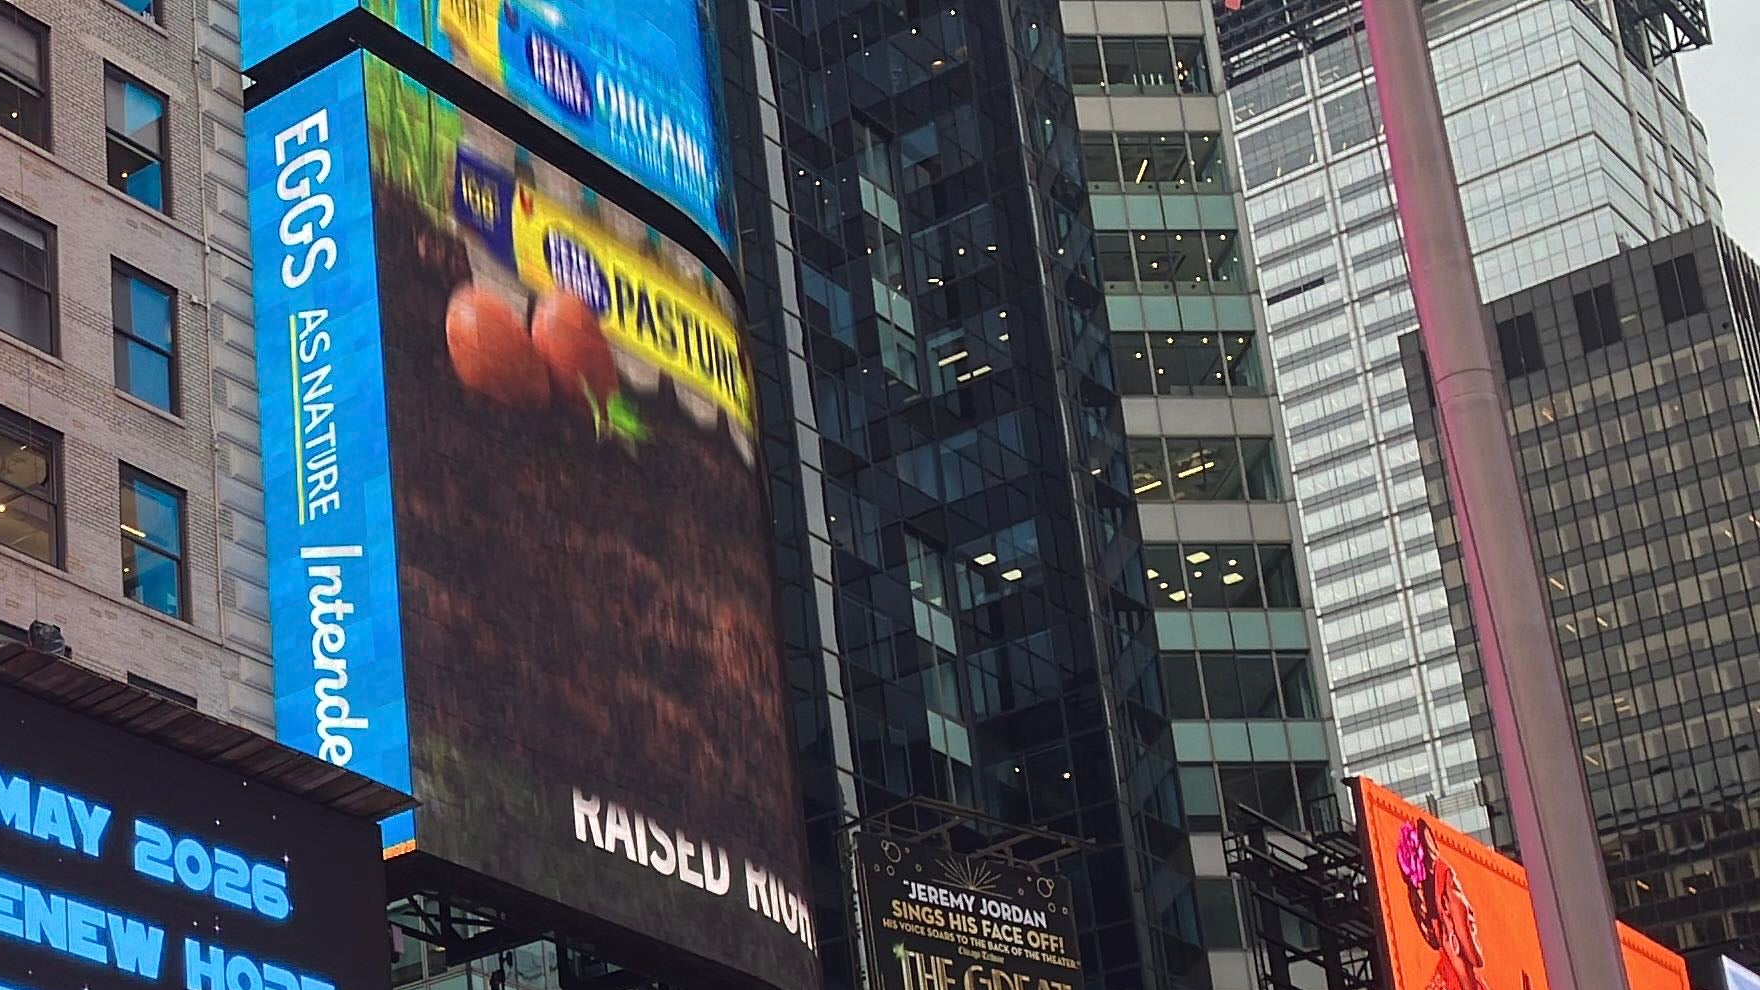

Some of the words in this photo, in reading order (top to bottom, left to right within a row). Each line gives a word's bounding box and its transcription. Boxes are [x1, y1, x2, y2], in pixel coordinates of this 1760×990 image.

[273, 109, 338, 288] EGGS
[298, 309, 330, 360] AS
[302, 368, 341, 521] NATURE
[135, 819, 291, 920] 2026
[572, 785, 730, 896] RAISED
[745, 858, 818, 959] RIGH
[882, 917, 898, 930] HIS
[899, 921, 925, 936] VOICE
[926, 927, 955, 943] SOARS
[956, 933, 969, 945] TO
[970, 936, 987, 950] THE
[988, 940, 1010, 955] BACK
[1011, 946, 1023, 957] OF
[1024, 949, 1041, 962] THE
[891, 899, 945, 926] SINGS
[948, 912, 978, 935] HIS
[982, 921, 1023, 946] FACE
[1027, 932, 1064, 954] OFF!
[979, 897, 1047, 929] JORDAN
